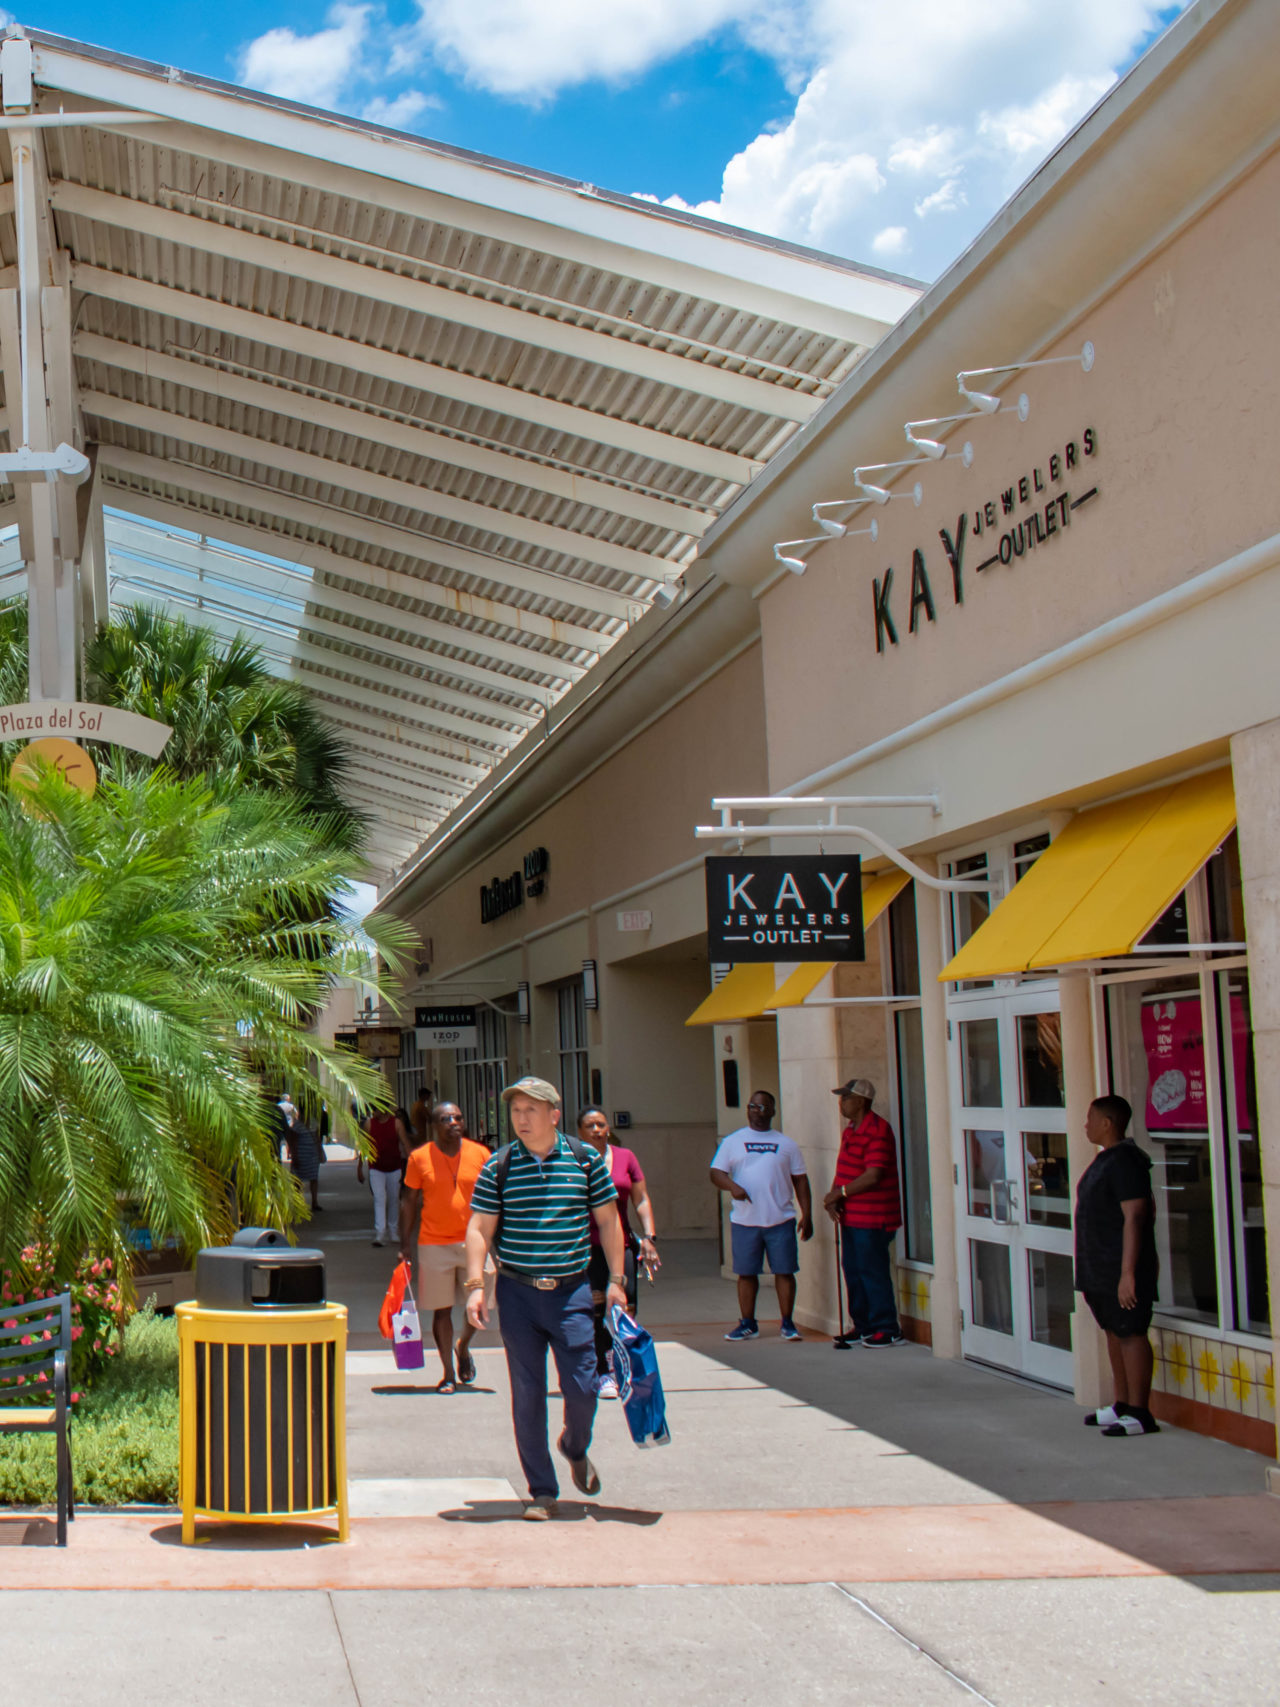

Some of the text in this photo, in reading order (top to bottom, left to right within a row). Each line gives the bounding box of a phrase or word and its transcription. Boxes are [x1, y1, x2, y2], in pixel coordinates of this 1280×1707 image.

[972, 428, 1094, 535] JEWELERS
[999, 492, 1068, 565] OUTLET
[872, 513, 967, 653] KAY
[0, 708, 103, 733] Plaza del Sol
[727, 872, 849, 910] KAY
[723, 914, 850, 926] JEWELERS
[752, 930, 822, 943] OUTLET
[433, 1031, 460, 1039] IZOD
